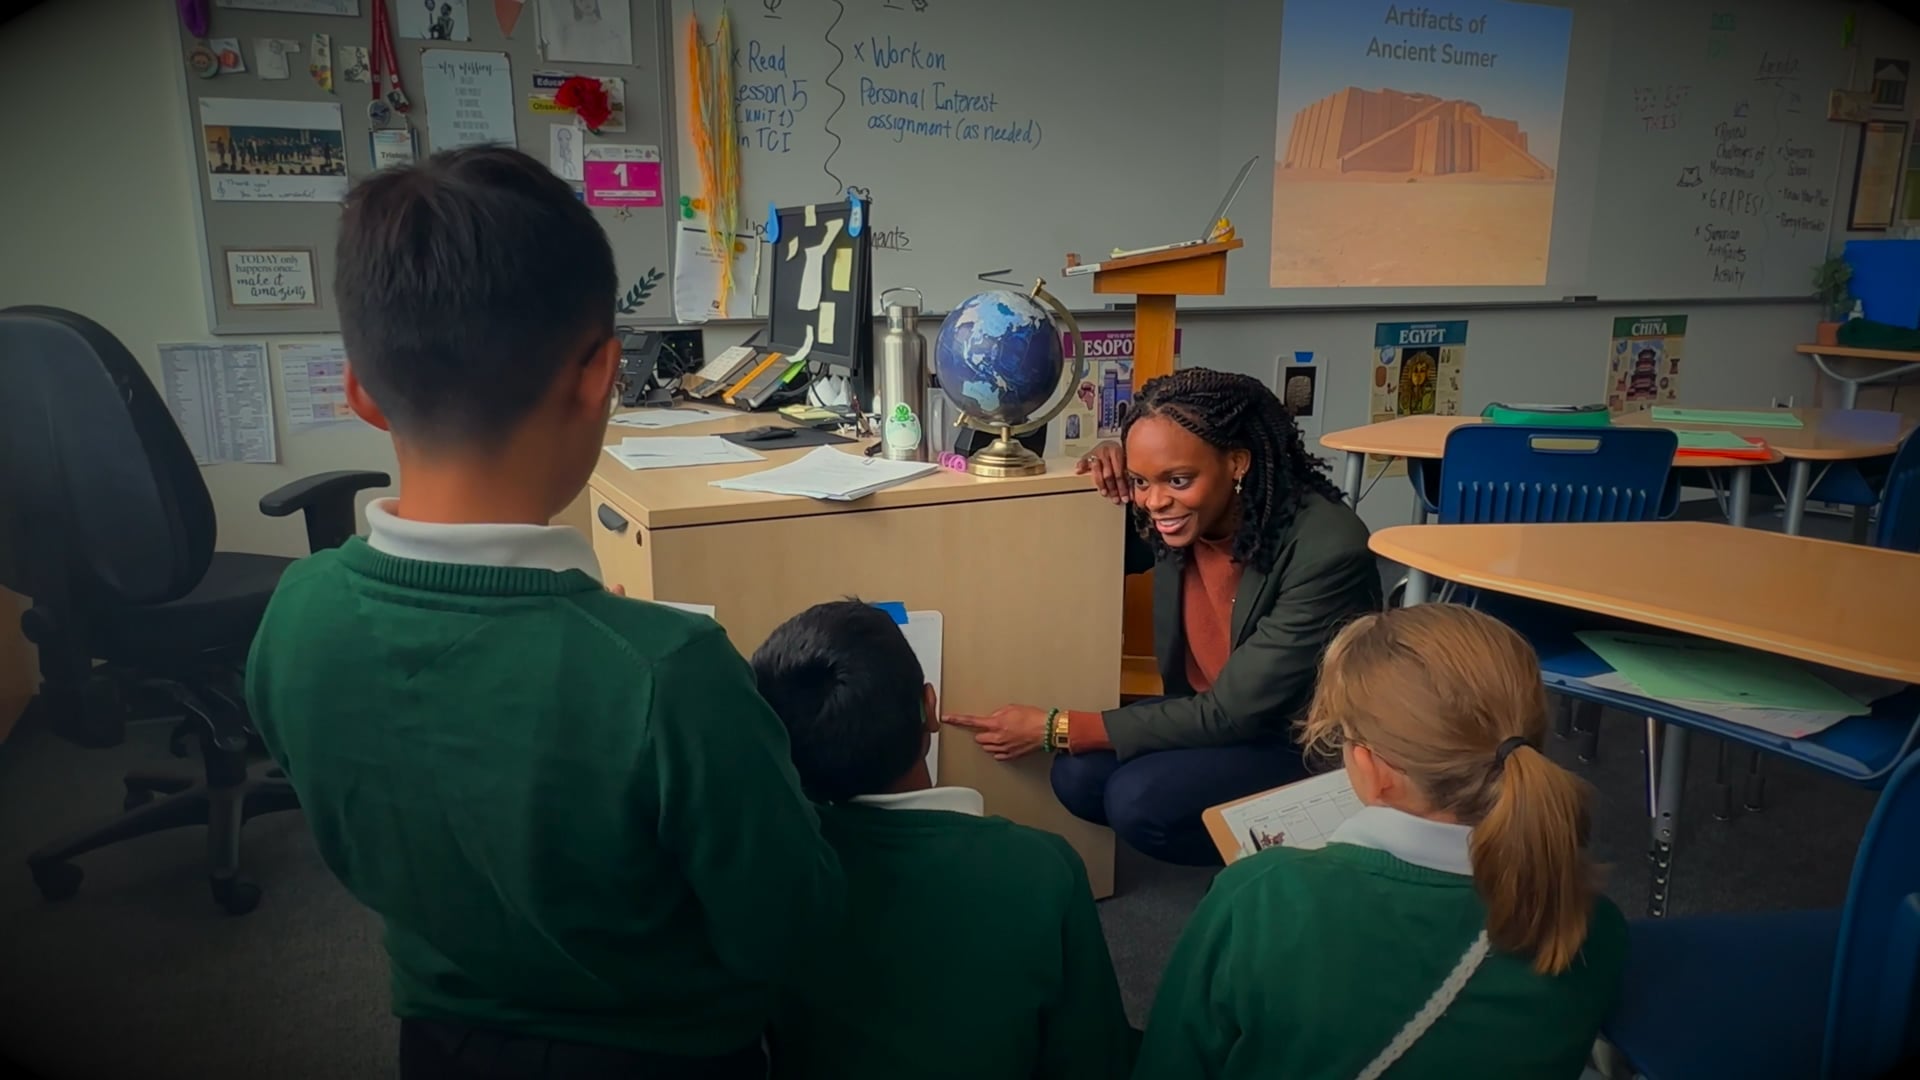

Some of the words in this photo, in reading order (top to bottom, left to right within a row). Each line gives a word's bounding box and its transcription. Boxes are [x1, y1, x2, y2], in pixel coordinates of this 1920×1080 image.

[1385, 4, 1463, 32] Artifacts
[1468, 14, 1487, 34] of
[749, 40, 787, 78] Read
[871, 35, 923, 69] Work
[925, 53, 946, 70] on
[1366, 36, 1436, 62] Ancient
[1441, 43, 1498, 68] Sumer
[792, 80, 808, 112] 5
[860, 76, 925, 110] Personal
[933, 82, 998, 113] Interest
[756, 127, 791, 153] TCI
[868, 114, 951, 143] assignment
[956, 118, 979, 141] (as
[984, 119, 1042, 150] needed)
[613, 163, 629, 187] 1
[235, 264, 272, 275] happens
[239, 254, 279, 265] TODAY
[280, 255, 299, 268] only
[237, 273, 270, 286] make
[273, 273, 284, 287] it
[250, 285, 307, 301] amazing
[1398, 328, 1447, 345] EGYPT
[1631, 322, 1668, 336] CHINA
